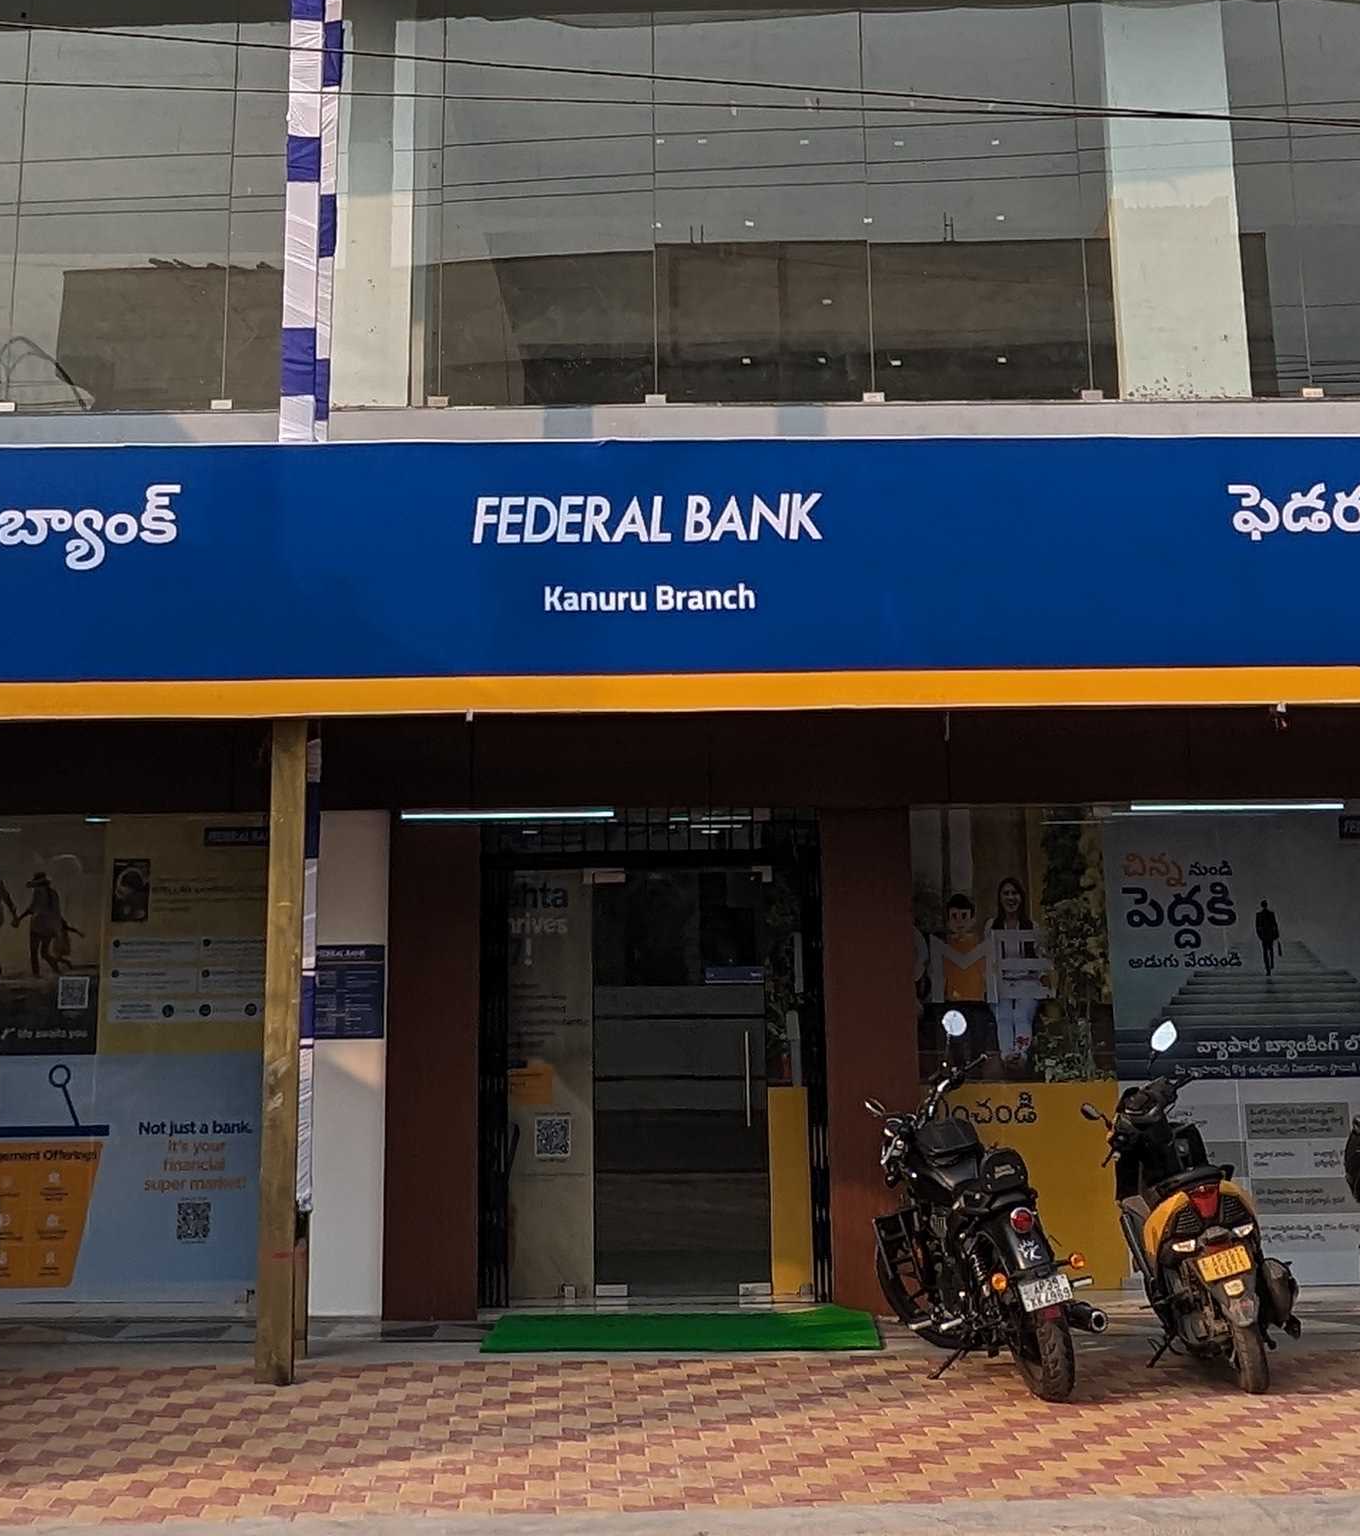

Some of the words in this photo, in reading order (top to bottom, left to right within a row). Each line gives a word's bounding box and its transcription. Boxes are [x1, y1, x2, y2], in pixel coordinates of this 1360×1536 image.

[472, 495, 671, 544] FEDERAL
[683, 492, 823, 541] BANK
[543, 586, 646, 611] Kanuru
[655, 583, 756, 611] Branch
[1121, 882, 1238, 950] పెద్దకి
[138, 1121, 166, 1135] Not
[168, 1120, 197, 1137] just
[199, 1122, 209, 1134] a
[212, 1120, 253, 1135] bank.
[143, 1178, 187, 1194] super
